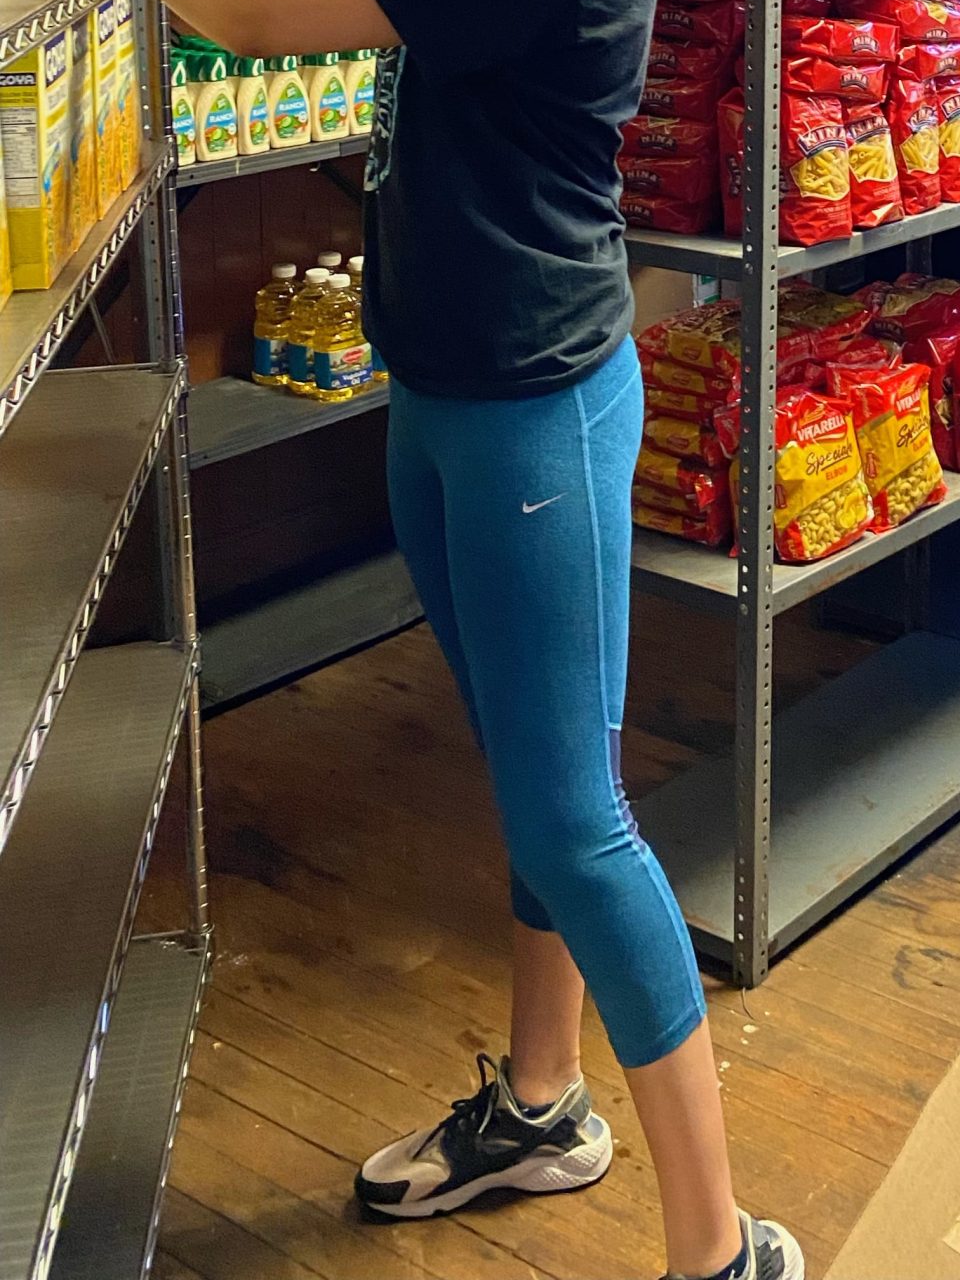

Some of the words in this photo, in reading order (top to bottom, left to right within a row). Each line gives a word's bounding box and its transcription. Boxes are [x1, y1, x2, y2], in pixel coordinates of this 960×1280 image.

[279, 101, 306, 112] RANCH
[209, 112, 236, 124] RANCH
[805, 127, 847, 148] NINA
